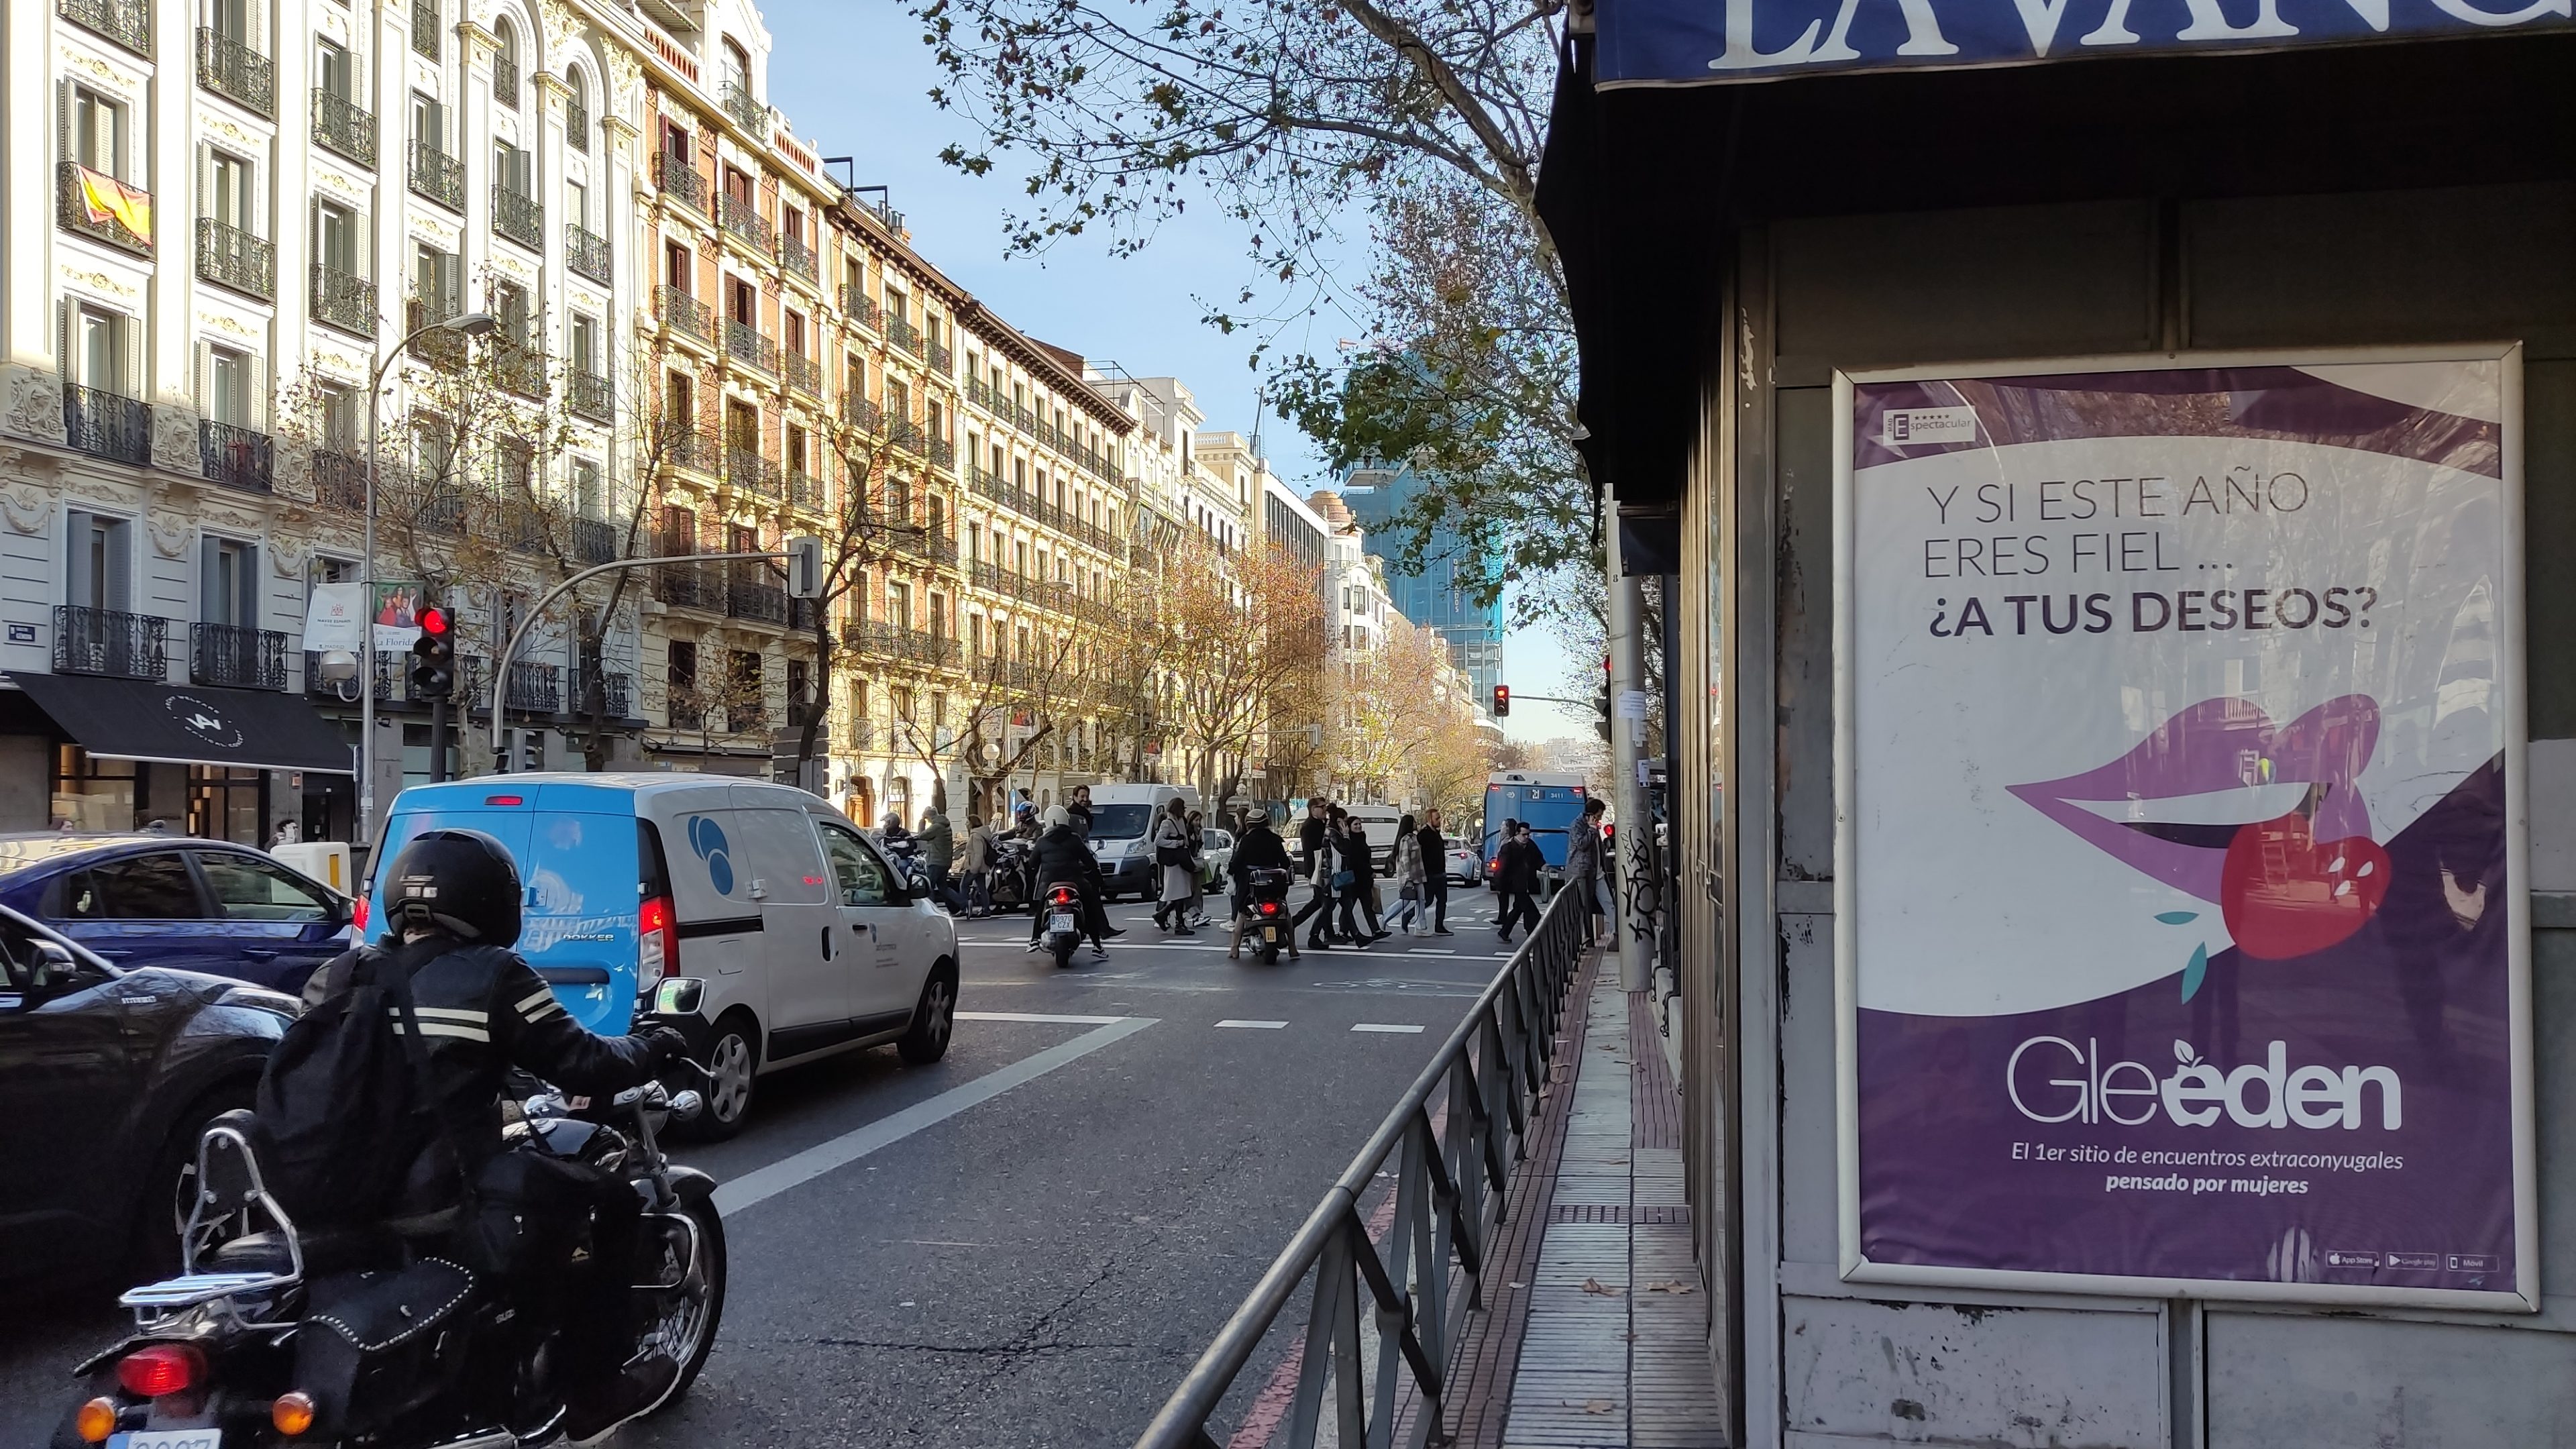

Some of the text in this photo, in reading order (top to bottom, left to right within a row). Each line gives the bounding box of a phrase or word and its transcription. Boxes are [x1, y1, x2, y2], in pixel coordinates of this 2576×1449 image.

[1926, 466, 2308, 525] Y SI ESTE AÑO
[1925, 535, 2049, 578] ERES
[2072, 531, 2181, 574] FIEL
[1452, 558, 1460, 613] DRADOS
[1929, 586, 2378, 638] ¿A TUS DESEOS?
[2011, 1142, 2404, 1173] El 1er sitio de encuentros extraconyugales
[2105, 1173, 2309, 1197] pensado por mujeres
[2341, 1256, 2373, 1265] App Store
